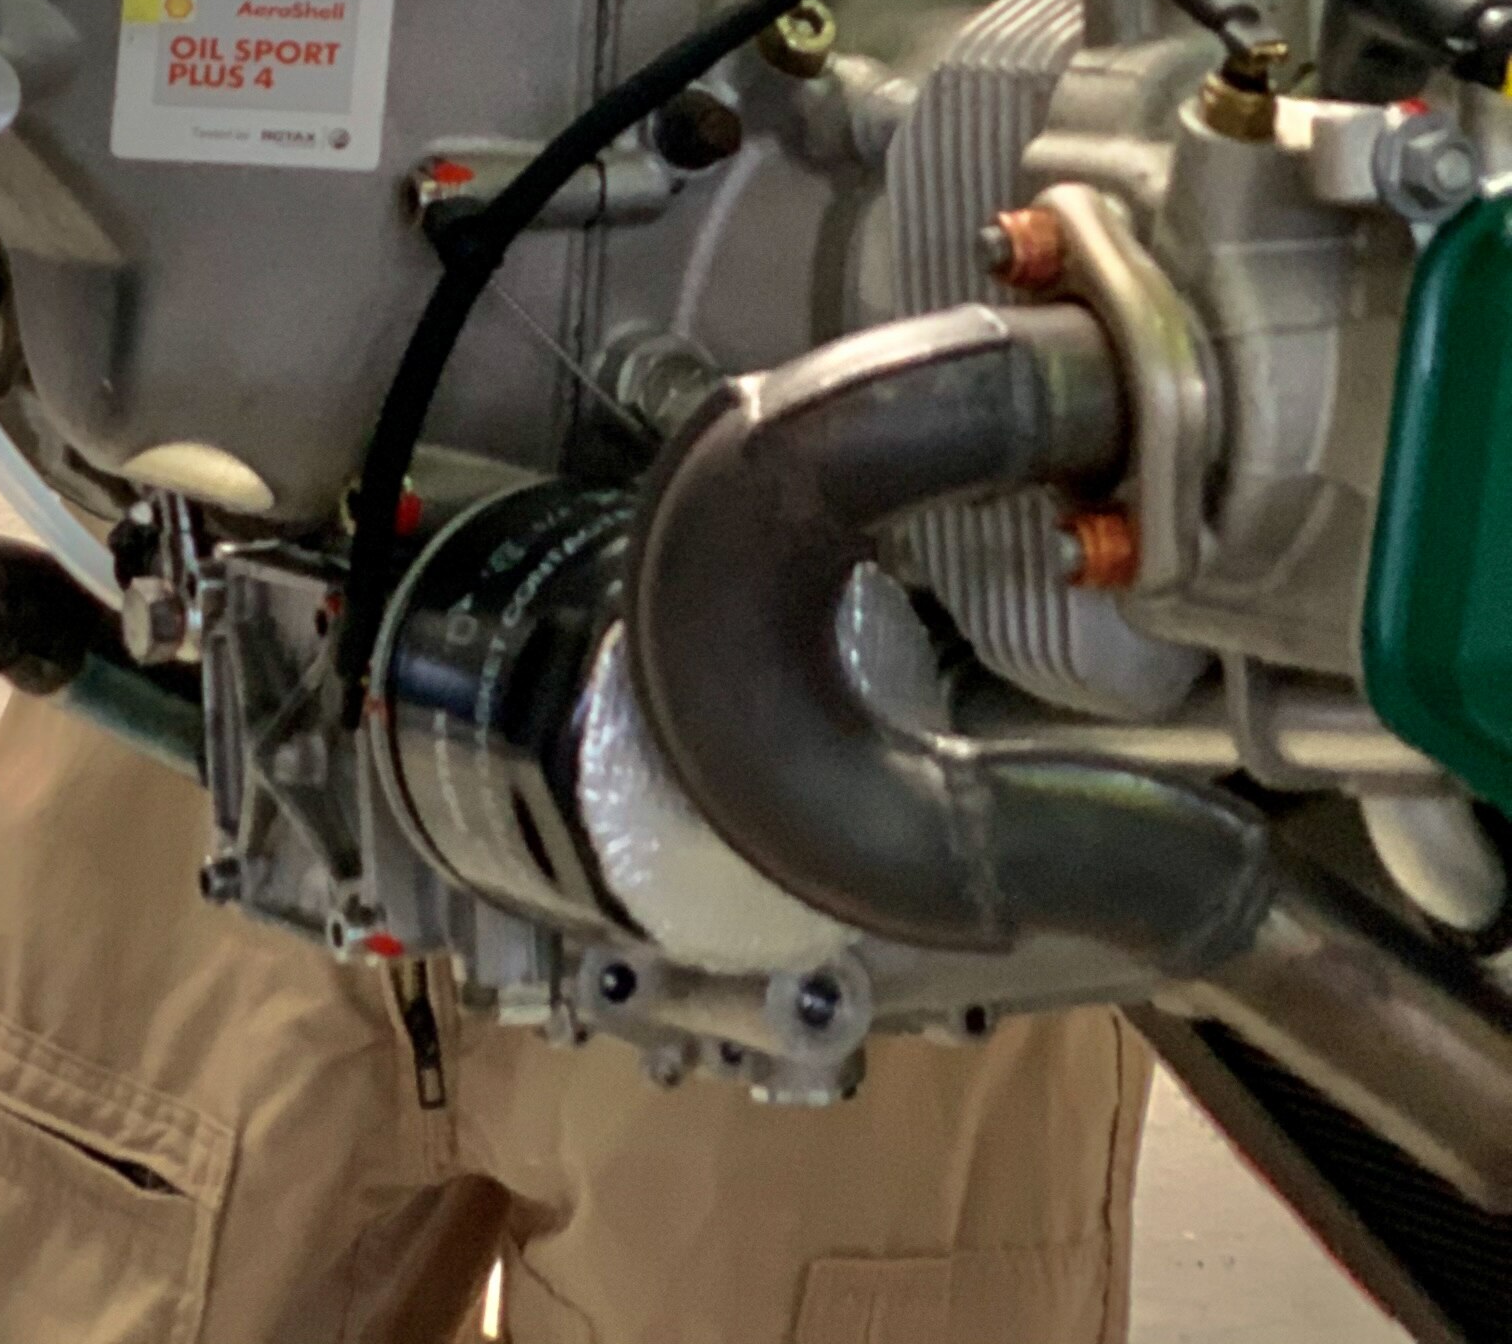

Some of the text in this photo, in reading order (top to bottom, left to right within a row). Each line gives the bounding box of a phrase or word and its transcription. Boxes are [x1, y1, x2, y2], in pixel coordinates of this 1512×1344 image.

[236, 0, 346, 20] AeroShell
[169, 35, 342, 66] OIL SPORT
[167, 63, 275, 89] PLUS 4
